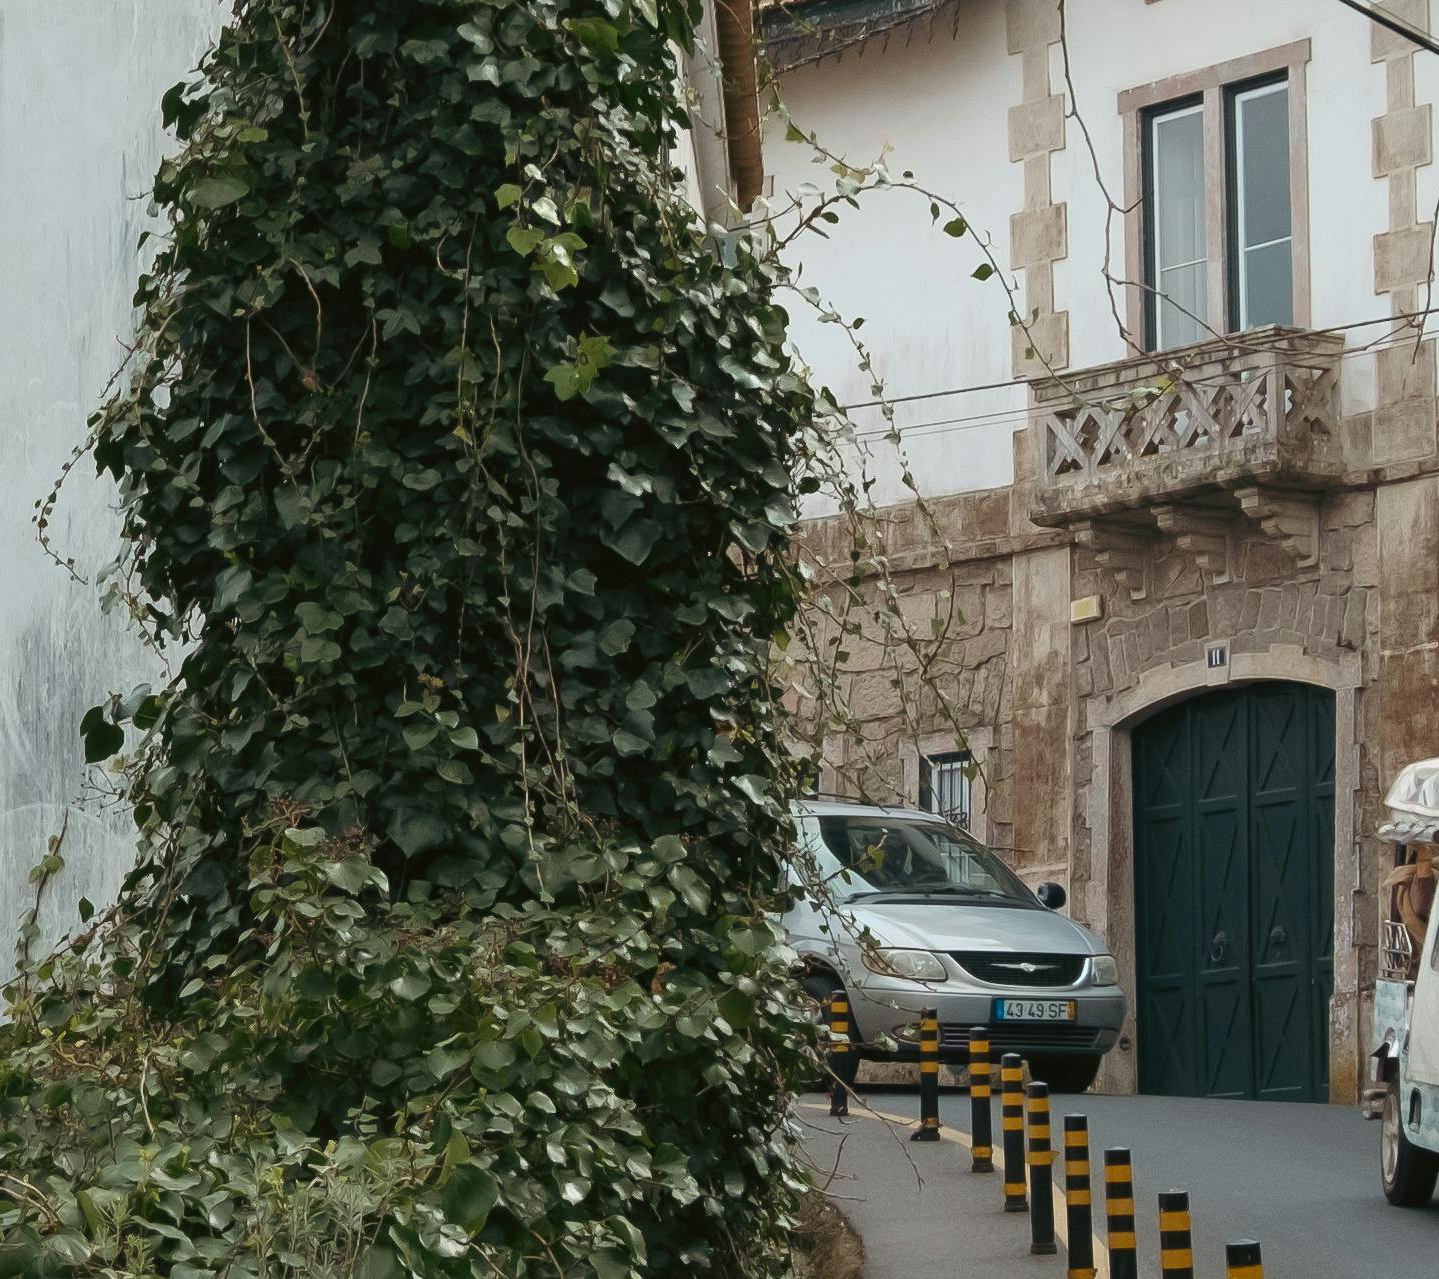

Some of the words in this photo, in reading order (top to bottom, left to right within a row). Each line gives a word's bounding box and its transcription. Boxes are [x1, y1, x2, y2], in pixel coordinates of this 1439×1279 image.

[1006, 1002, 1023, 1018] 43
[1027, 1003, 1044, 1018] 49
[1048, 1003, 1068, 1019] SF
